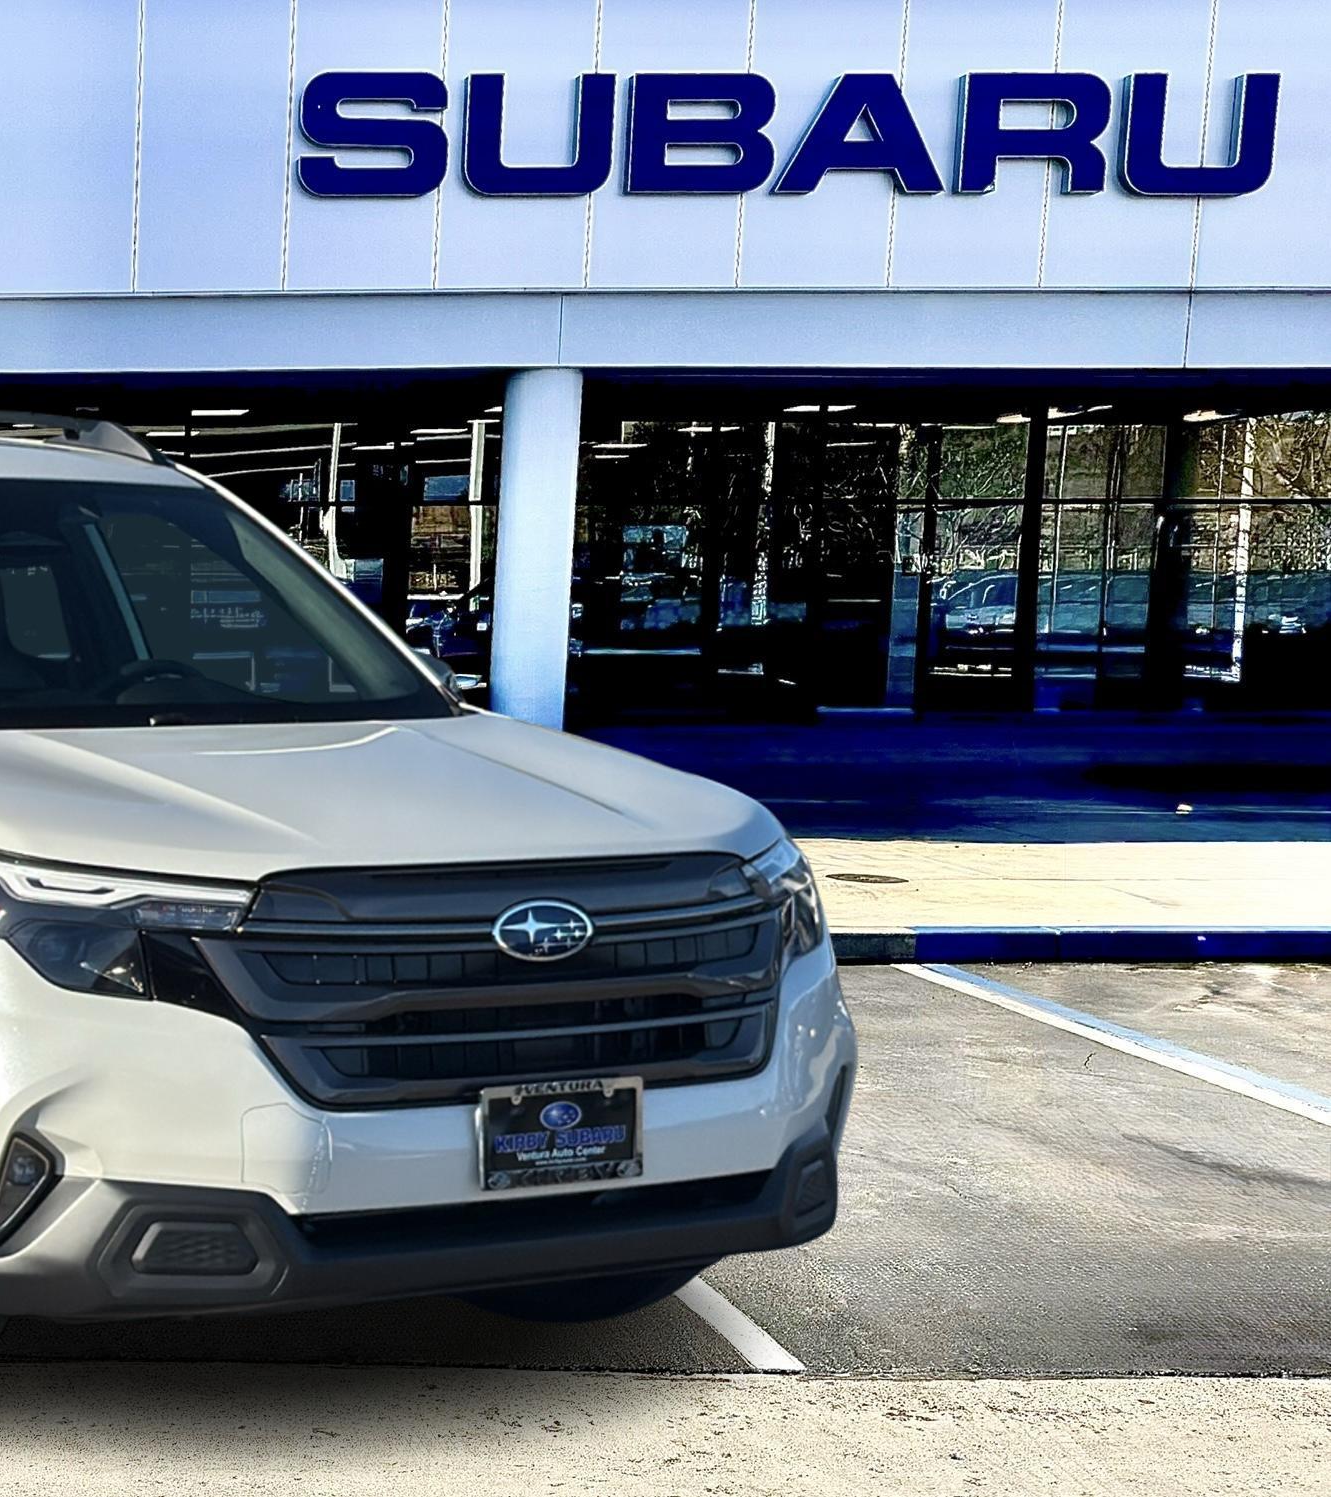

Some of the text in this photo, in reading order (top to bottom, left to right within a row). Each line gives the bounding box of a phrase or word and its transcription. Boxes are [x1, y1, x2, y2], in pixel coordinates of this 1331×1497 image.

[297, 70, 1281, 197] SUBARU
[494, 1125, 627, 1153] KIRBY SUBARU
[516, 1149, 550, 1162] Ventura
[551, 1148, 574, 1158] Auto
[576, 1145, 606, 1157] Center
